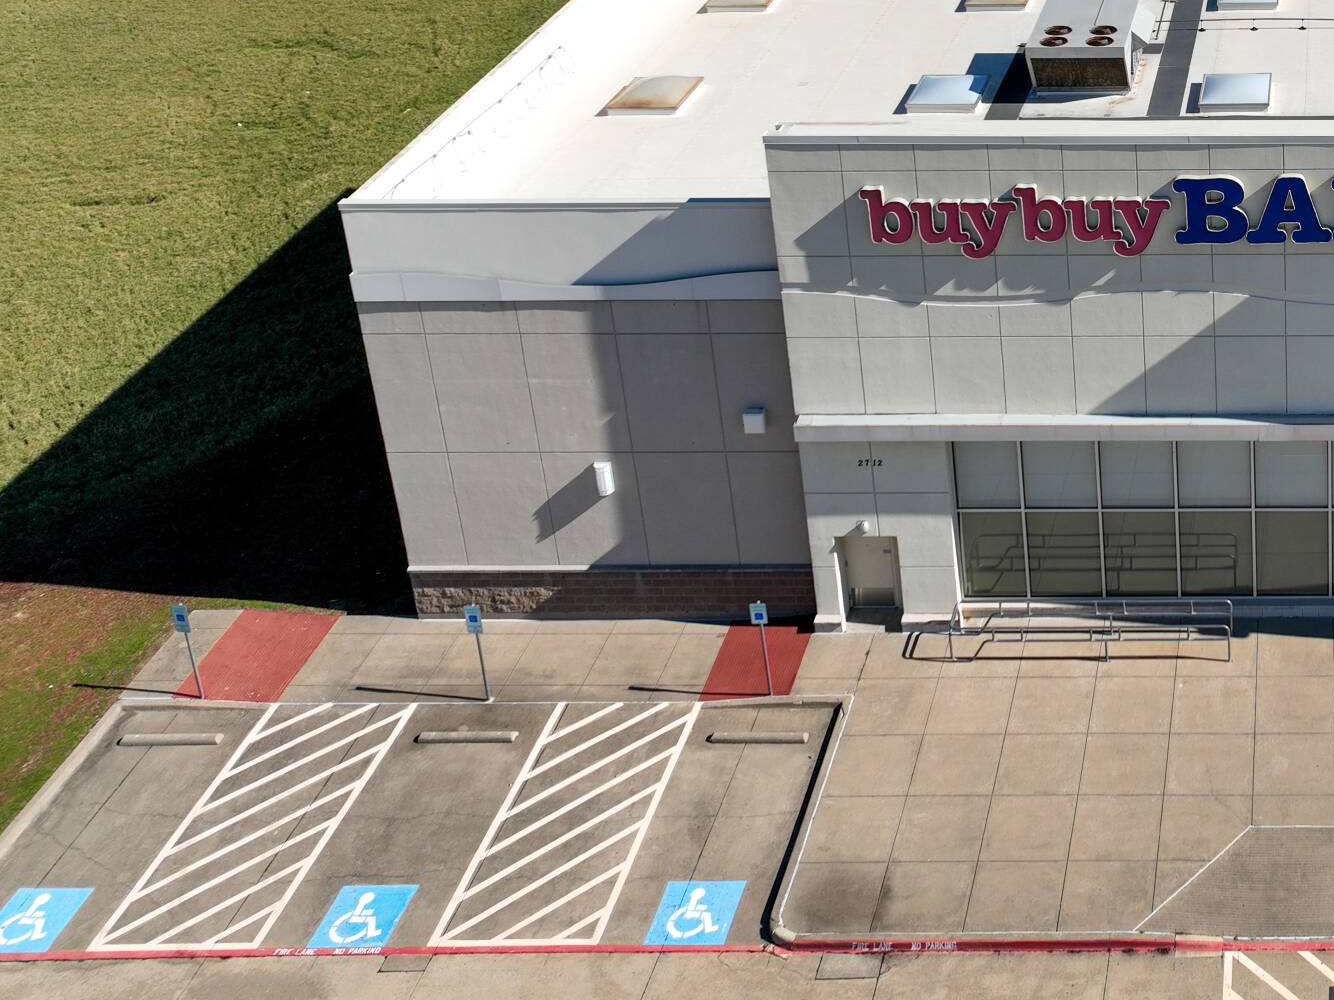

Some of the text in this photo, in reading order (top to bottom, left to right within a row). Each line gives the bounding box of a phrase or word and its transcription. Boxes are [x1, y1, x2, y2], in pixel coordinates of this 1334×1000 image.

[857, 459, 883, 467] 2712
[852, 942, 869, 951] FIRE
[873, 942, 893, 951] LANE
[925, 941, 957, 950] PARKING
